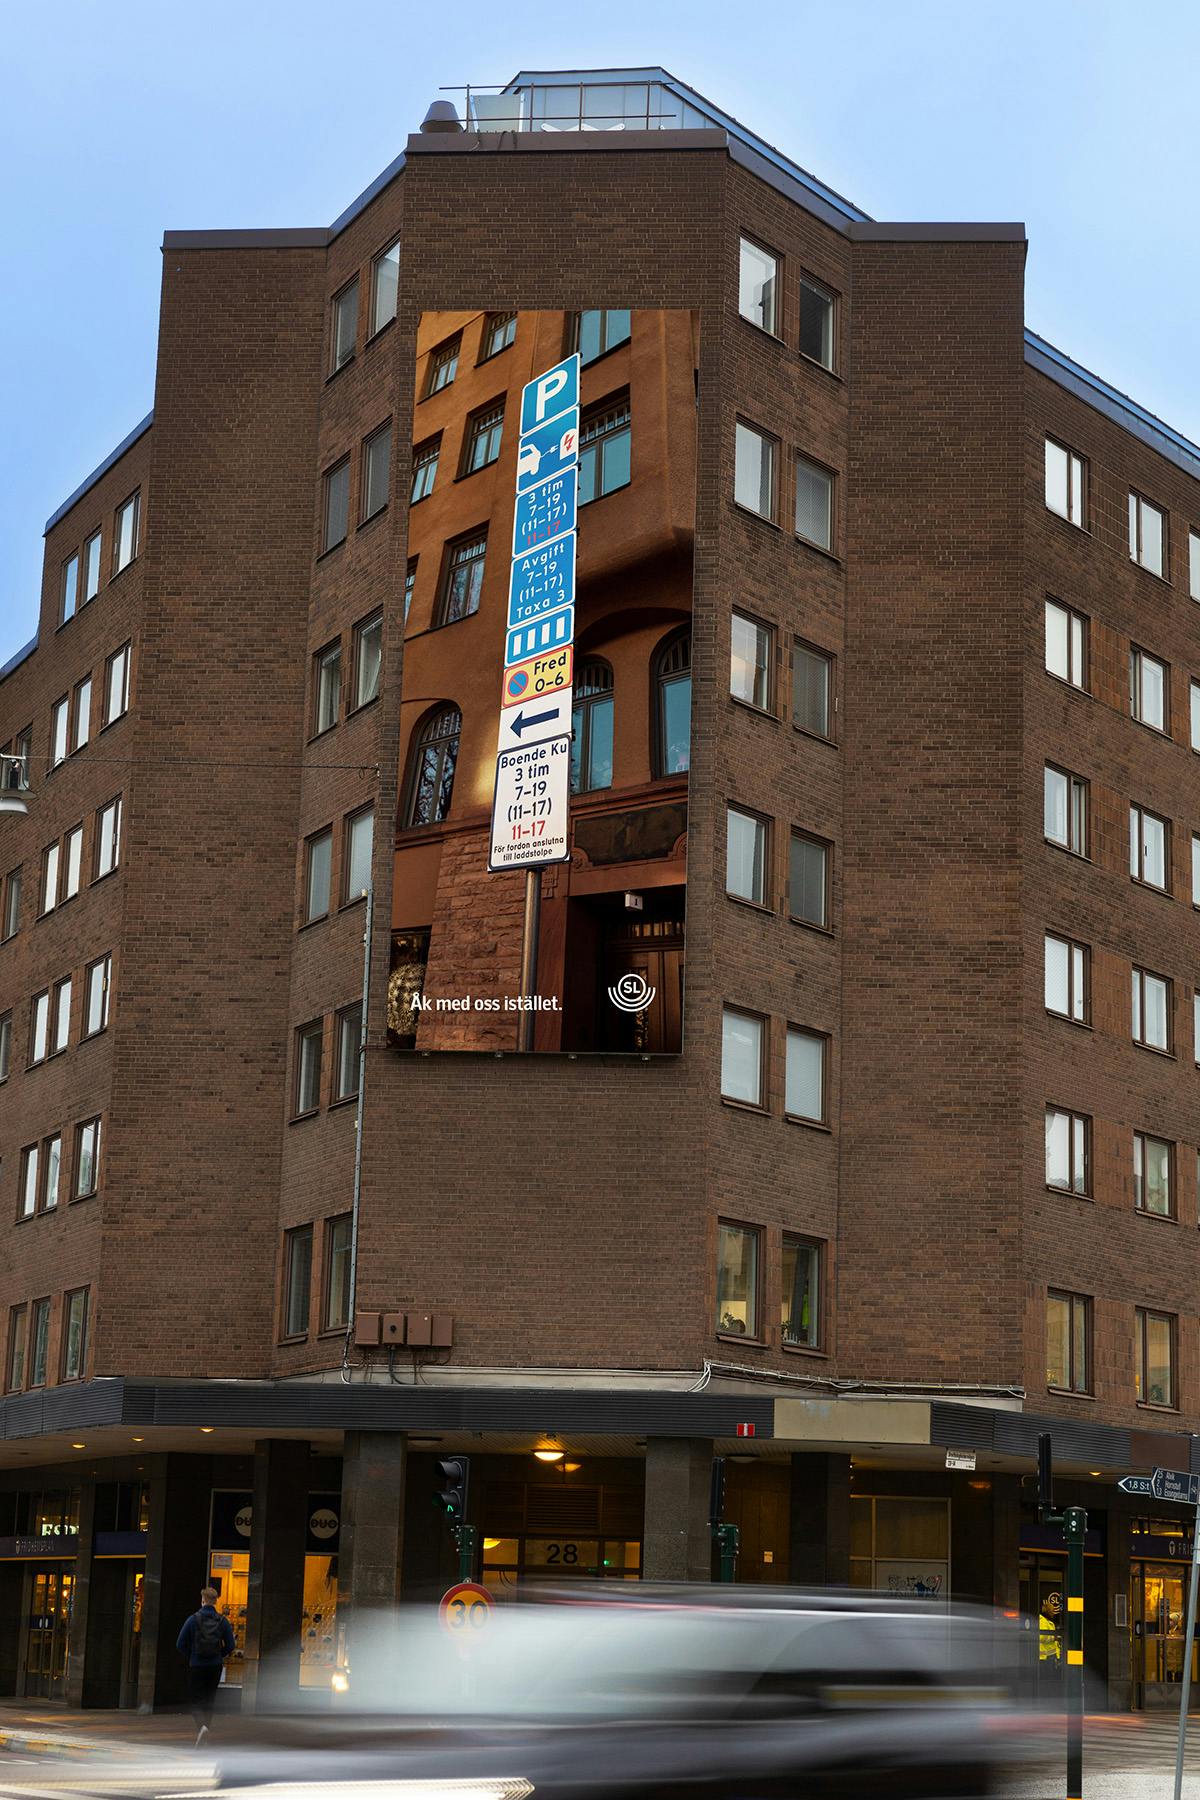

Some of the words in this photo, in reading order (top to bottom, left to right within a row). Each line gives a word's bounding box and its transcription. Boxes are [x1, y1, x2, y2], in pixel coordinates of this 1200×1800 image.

[535, 369, 568, 422] P
[528, 492, 536, 504] 3
[542, 479, 563, 497] tim
[530, 493, 561, 517] 7-19
[521, 502, 567, 535] (11-17)
[527, 520, 561, 545] 11-17
[522, 542, 565, 571] Avgift
[527, 561, 557, 583] 7-19
[519, 573, 563, 603] (11-17)
[516, 598, 550, 619] Taxa
[556, 590, 565, 602] 3
[533, 652, 566, 675] Fred
[535, 672, 564, 692] 0-6
[501, 748, 546, 769] Boende
[551, 742, 568, 756] Ku
[514, 768, 523, 782] 3
[528, 763, 549, 779] tim
[515, 780, 547, 800] 7-19
[508, 798, 552, 823] (11-17)
[512, 821, 546, 840] 11-17
[494, 844, 505, 854] För
[507, 841, 531, 852] fordon
[532, 836, 564, 849] anslutna
[503, 852, 512, 862] till
[513, 848, 553, 860] laddstolpe
[623, 982, 640, 994] SL
[410, 992, 432, 1011] Åk
[436, 995, 470, 1011] med
[476, 999, 500, 1011] oss
[504, 994, 562, 1011] istället.
[546, 1544, 578, 1564] 28
[450, 1600, 488, 1629] 30
